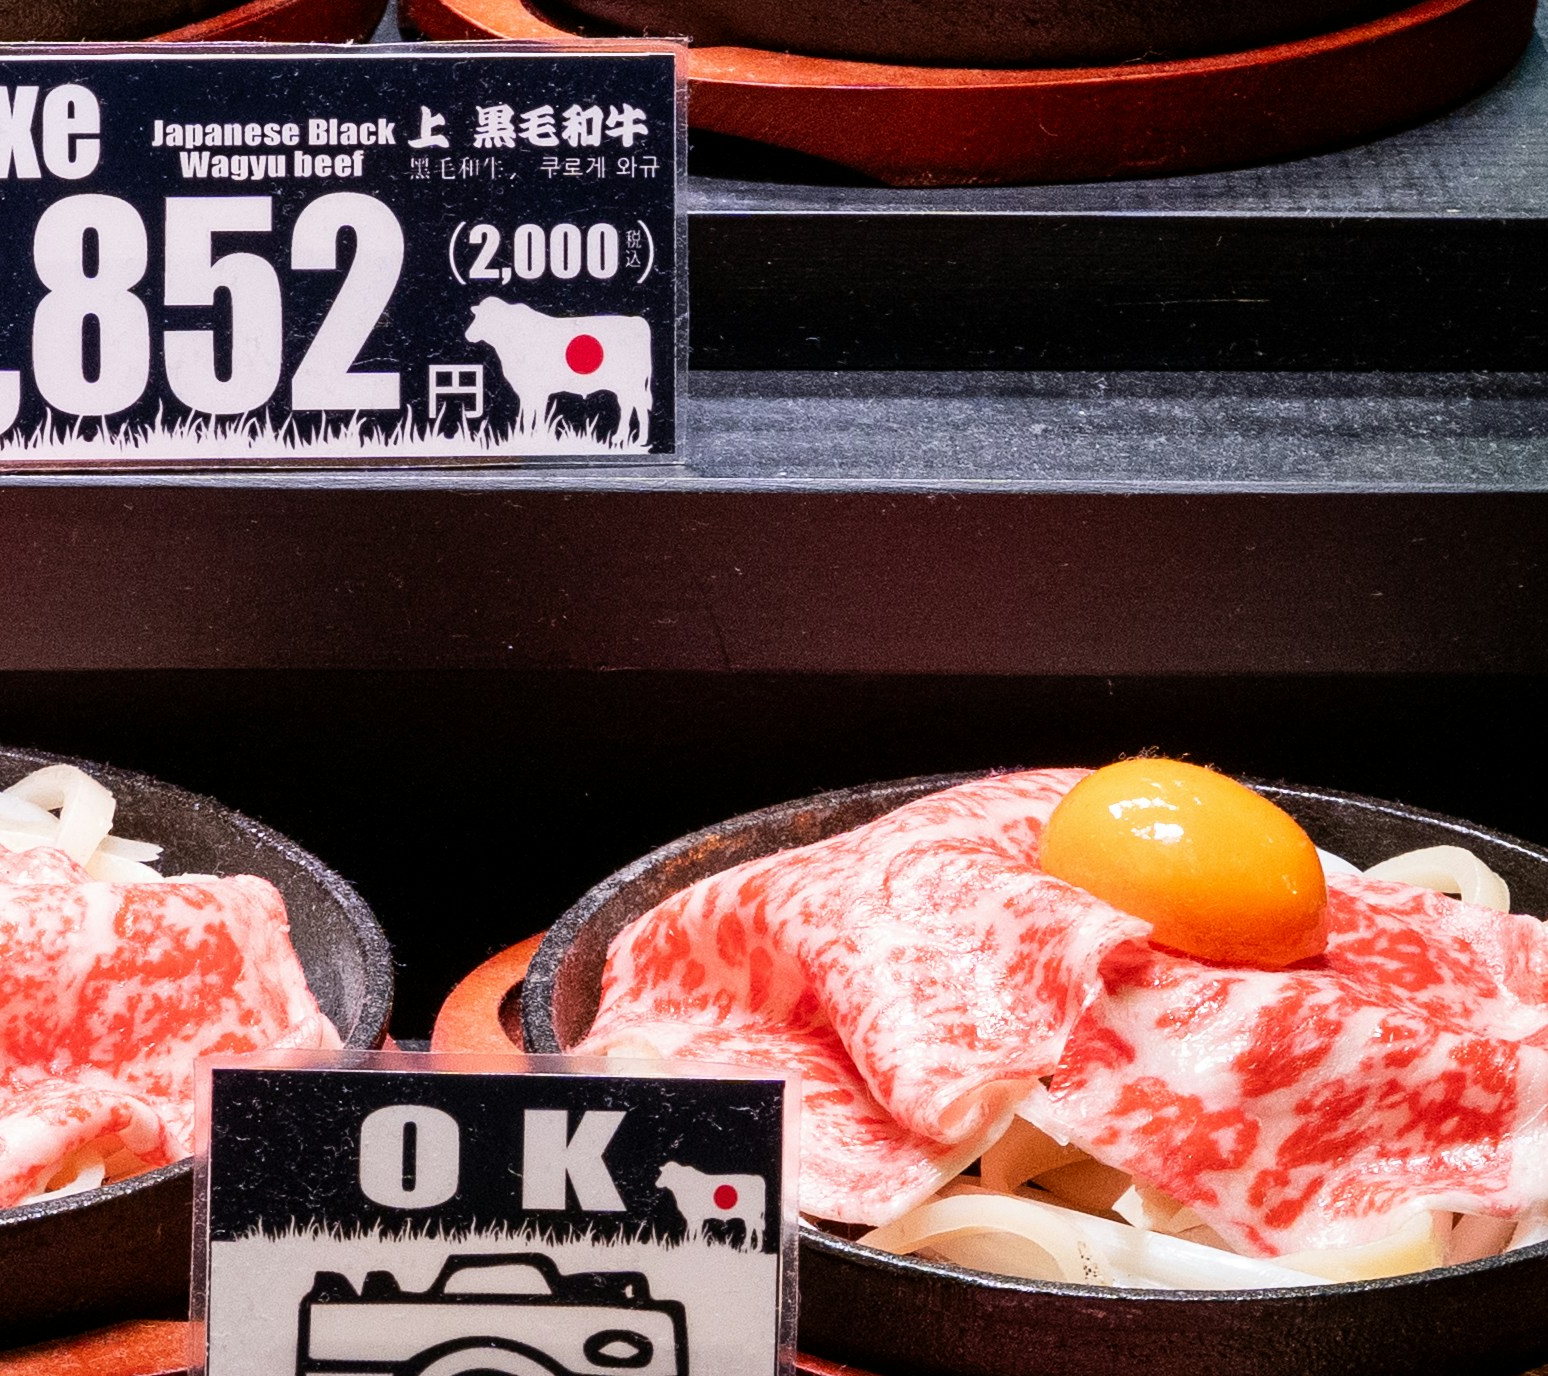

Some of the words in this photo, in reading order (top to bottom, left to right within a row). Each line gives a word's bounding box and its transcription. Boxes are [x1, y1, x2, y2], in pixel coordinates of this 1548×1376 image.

[152, 119, 299, 150] Japanese
[308, 118, 397, 146] Black
[407, 105, 450, 149] 上
[472, 102, 649, 149] 黒毛和牛
[179, 150, 286, 181] Wagyu
[293, 149, 365, 178] beef
[540, 156, 606, 179] 쿠로게
[616, 155, 660, 178] 와규
[429, 365, 484, 419] 円
